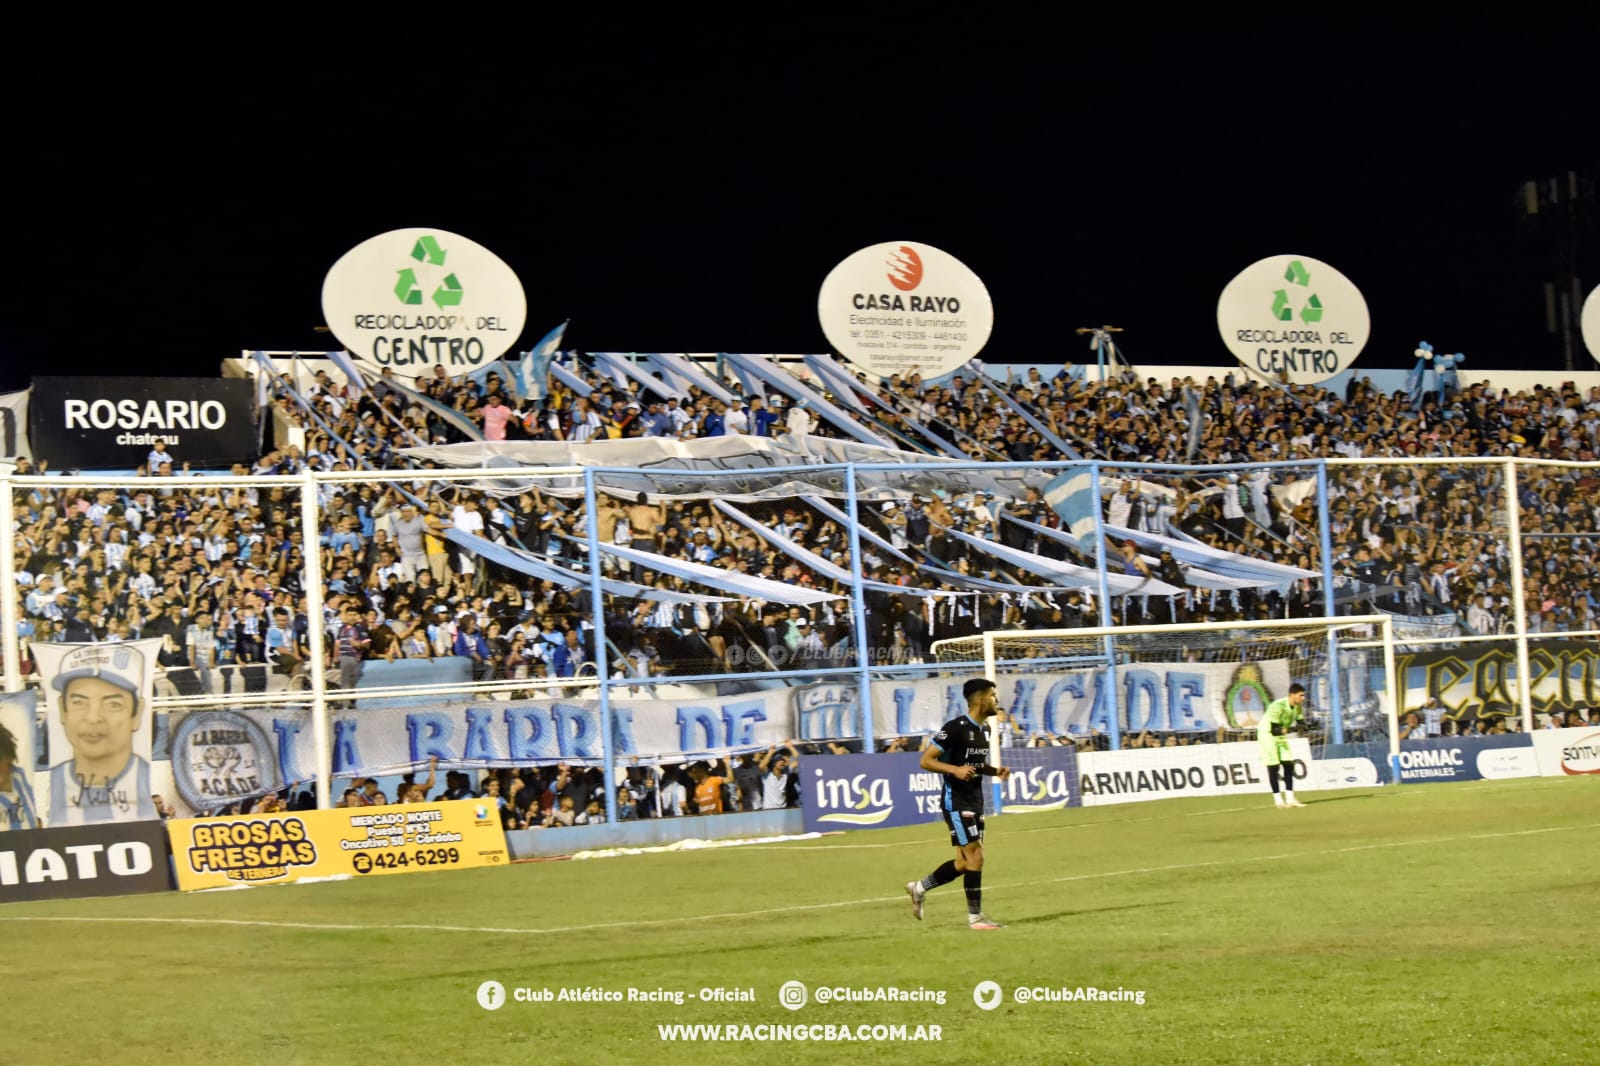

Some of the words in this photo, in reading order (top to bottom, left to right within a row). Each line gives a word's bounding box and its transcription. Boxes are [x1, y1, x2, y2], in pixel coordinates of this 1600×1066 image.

[852, 293, 905, 311] CASA
[910, 295, 960, 313] RAYO
[476, 317, 507, 331] DEL
[849, 314, 903, 326] Electricidad
[905, 318, 912, 326] e
[1237, 329, 1322, 344] RECICLADORA
[1330, 332, 1353, 344] DEL
[373, 335, 484, 366] CENTRO
[1257, 347, 1338, 373] CENTRO
[64, 399, 227, 430] ROSARIO
[192, 730, 208, 746] LA
[210, 729, 252, 745] BARRA
[1080, 765, 1205, 796] ARMANDO
[1212, 762, 1261, 787] DEL
[1401, 767, 1455, 778] MATERIALES
[200, 775, 261, 796] ACADE
[815, 768, 893, 811] insa
[1001, 766, 1069, 801] nsa
[915, 796, 924, 814] Y
[351, 813, 404, 827] MERCADO
[407, 810, 442, 823] NORTE
[193, 818, 305, 849] BROSAS
[340, 836, 389, 850] Oncativo
[391, 836, 404, 847] 50
[416, 832, 462, 845] Córdoba
[367, 825, 404, 837] Puesto
[189, 841, 317, 872] FRESCAS
[374, 848, 460, 869] 424-6299
